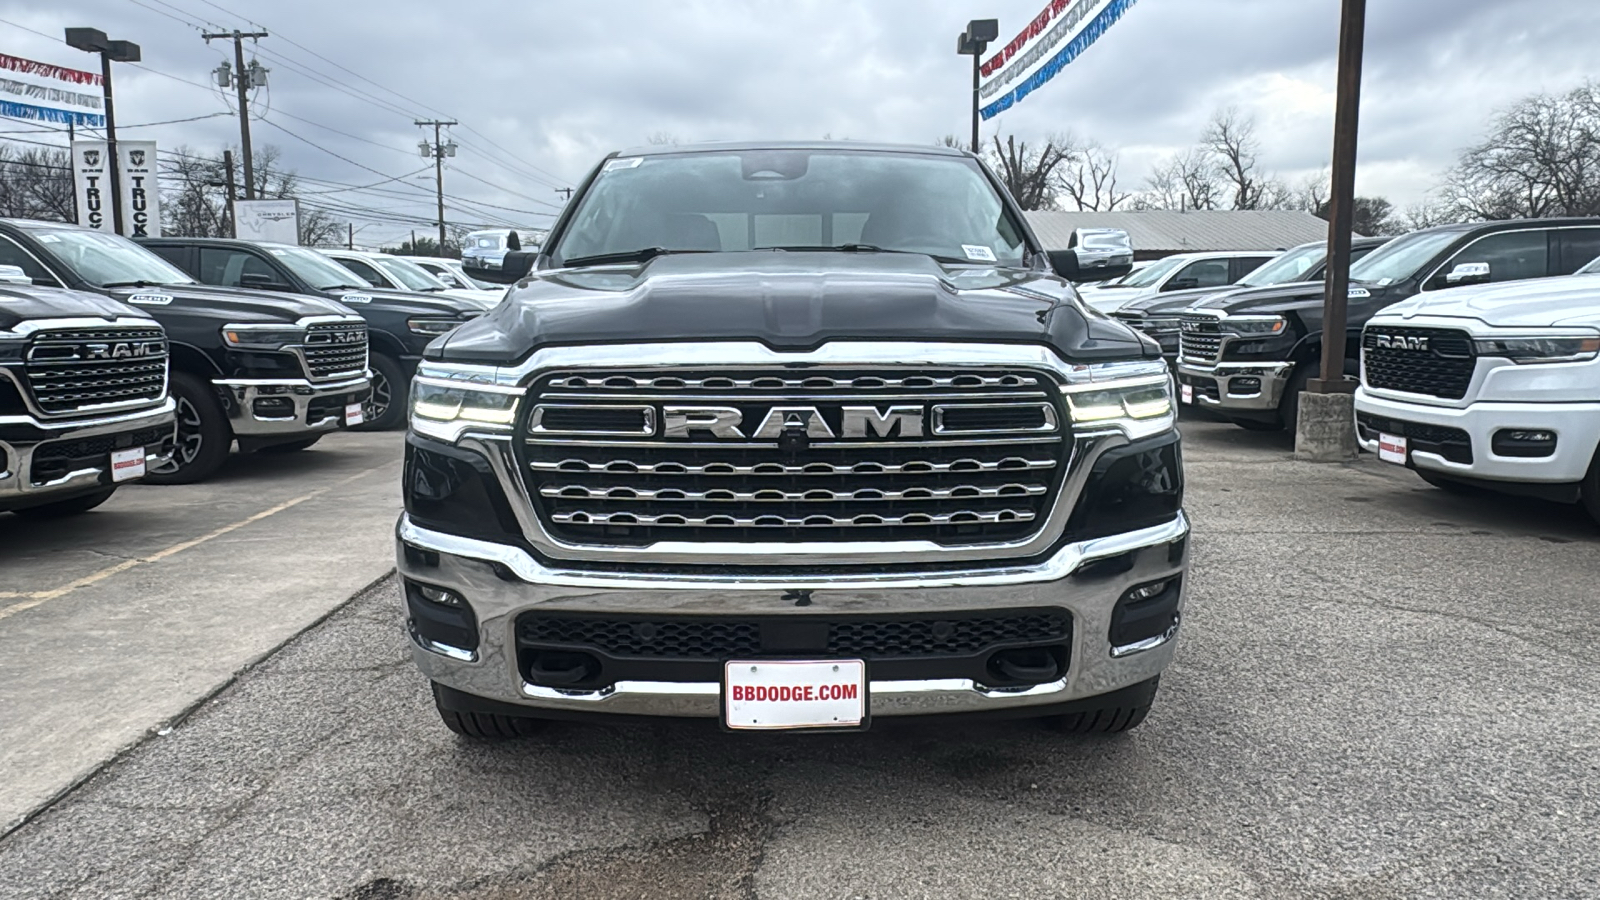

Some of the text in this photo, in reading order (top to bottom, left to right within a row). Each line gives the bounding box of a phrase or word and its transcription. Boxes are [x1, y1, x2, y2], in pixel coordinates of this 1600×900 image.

[131, 176, 148, 237] TRUCK
[86, 342, 150, 359] RAM
[1376, 334, 1429, 350] RAM
[663, 405, 924, 438] RAM
[732, 684, 857, 702] BBDODGE.COM
